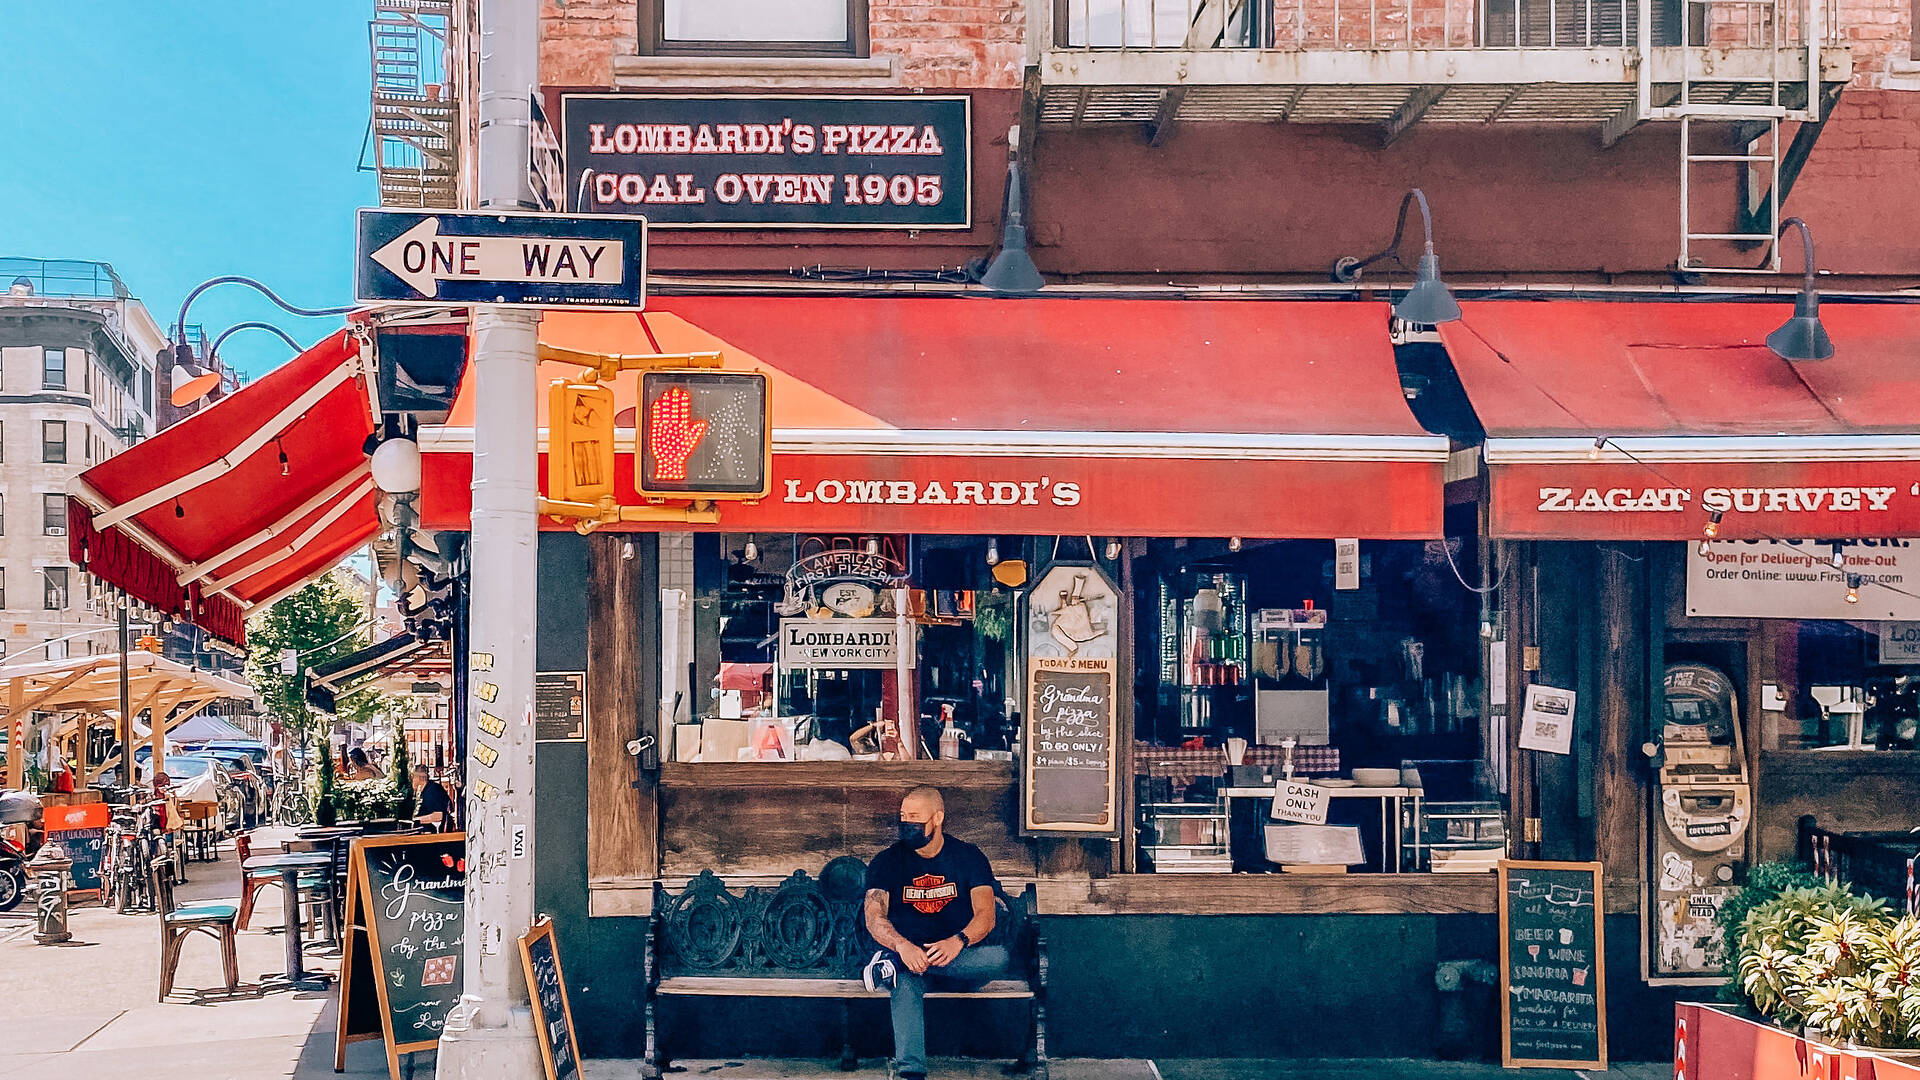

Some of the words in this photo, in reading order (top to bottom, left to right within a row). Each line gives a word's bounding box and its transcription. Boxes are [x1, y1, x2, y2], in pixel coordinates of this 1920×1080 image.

[589, 118, 815, 154] LOMBARDI'S
[822, 124, 943, 155] PIZZA
[596, 174, 705, 204] COAL
[715, 174, 834, 204] OVEN
[844, 175, 943, 205] 1905
[403, 240, 480, 275] ONE
[522, 244, 606, 278] WAY
[784, 476, 1080, 506] LOMBARDI'S
[1537, 487, 1691, 511] ZAGAT
[1701, 487, 1896, 512] SURVEY
[814, 553, 884, 569] AMERICA'S
[1706, 552, 1737, 564] Open
[1741, 552, 1758, 565] for
[1761, 553, 1812, 568] Delivery
[1841, 555, 1896, 566] Take-Out
[795, 565, 834, 588] FIRST
[839, 564, 898, 588] PIZZERIA
[1706, 569, 1739, 579] Order
[1742, 570, 1781, 580] Online:
[790, 629, 897, 646] LOMBARDI'
[1891, 625, 1920, 641] LO
[832, 648, 861, 657] YORK
[865, 648, 890, 657] CITY
[1079, 660, 1107, 669] MENU
[1040, 685, 1103, 712] Grandma
[1056, 706, 1098, 725] pizza
[1041, 724, 1053, 739] by
[1056, 726, 1074, 738] the
[1076, 727, 1103, 737] slice
[758, 725, 785, 758] A
[1040, 742, 1052, 751] TO
[1055, 743, 1069, 751] GO
[1287, 786, 1319, 798] CASH
[1286, 798, 1316, 811] ONLY
[1277, 809, 1302, 817] THANK
[409, 909, 459, 931] pizza
[1691, 908, 1712, 917] HEAD
[1515, 928, 1554, 940] BEER
[391, 937, 418, 959] by
[423, 934, 448, 951] the
[1548, 949, 1585, 962] WINE
[1523, 987, 1594, 1005] MARGARITA
[1563, 1006, 1578, 1018] for
[1561, 1021, 1596, 1032] DELIVERY
